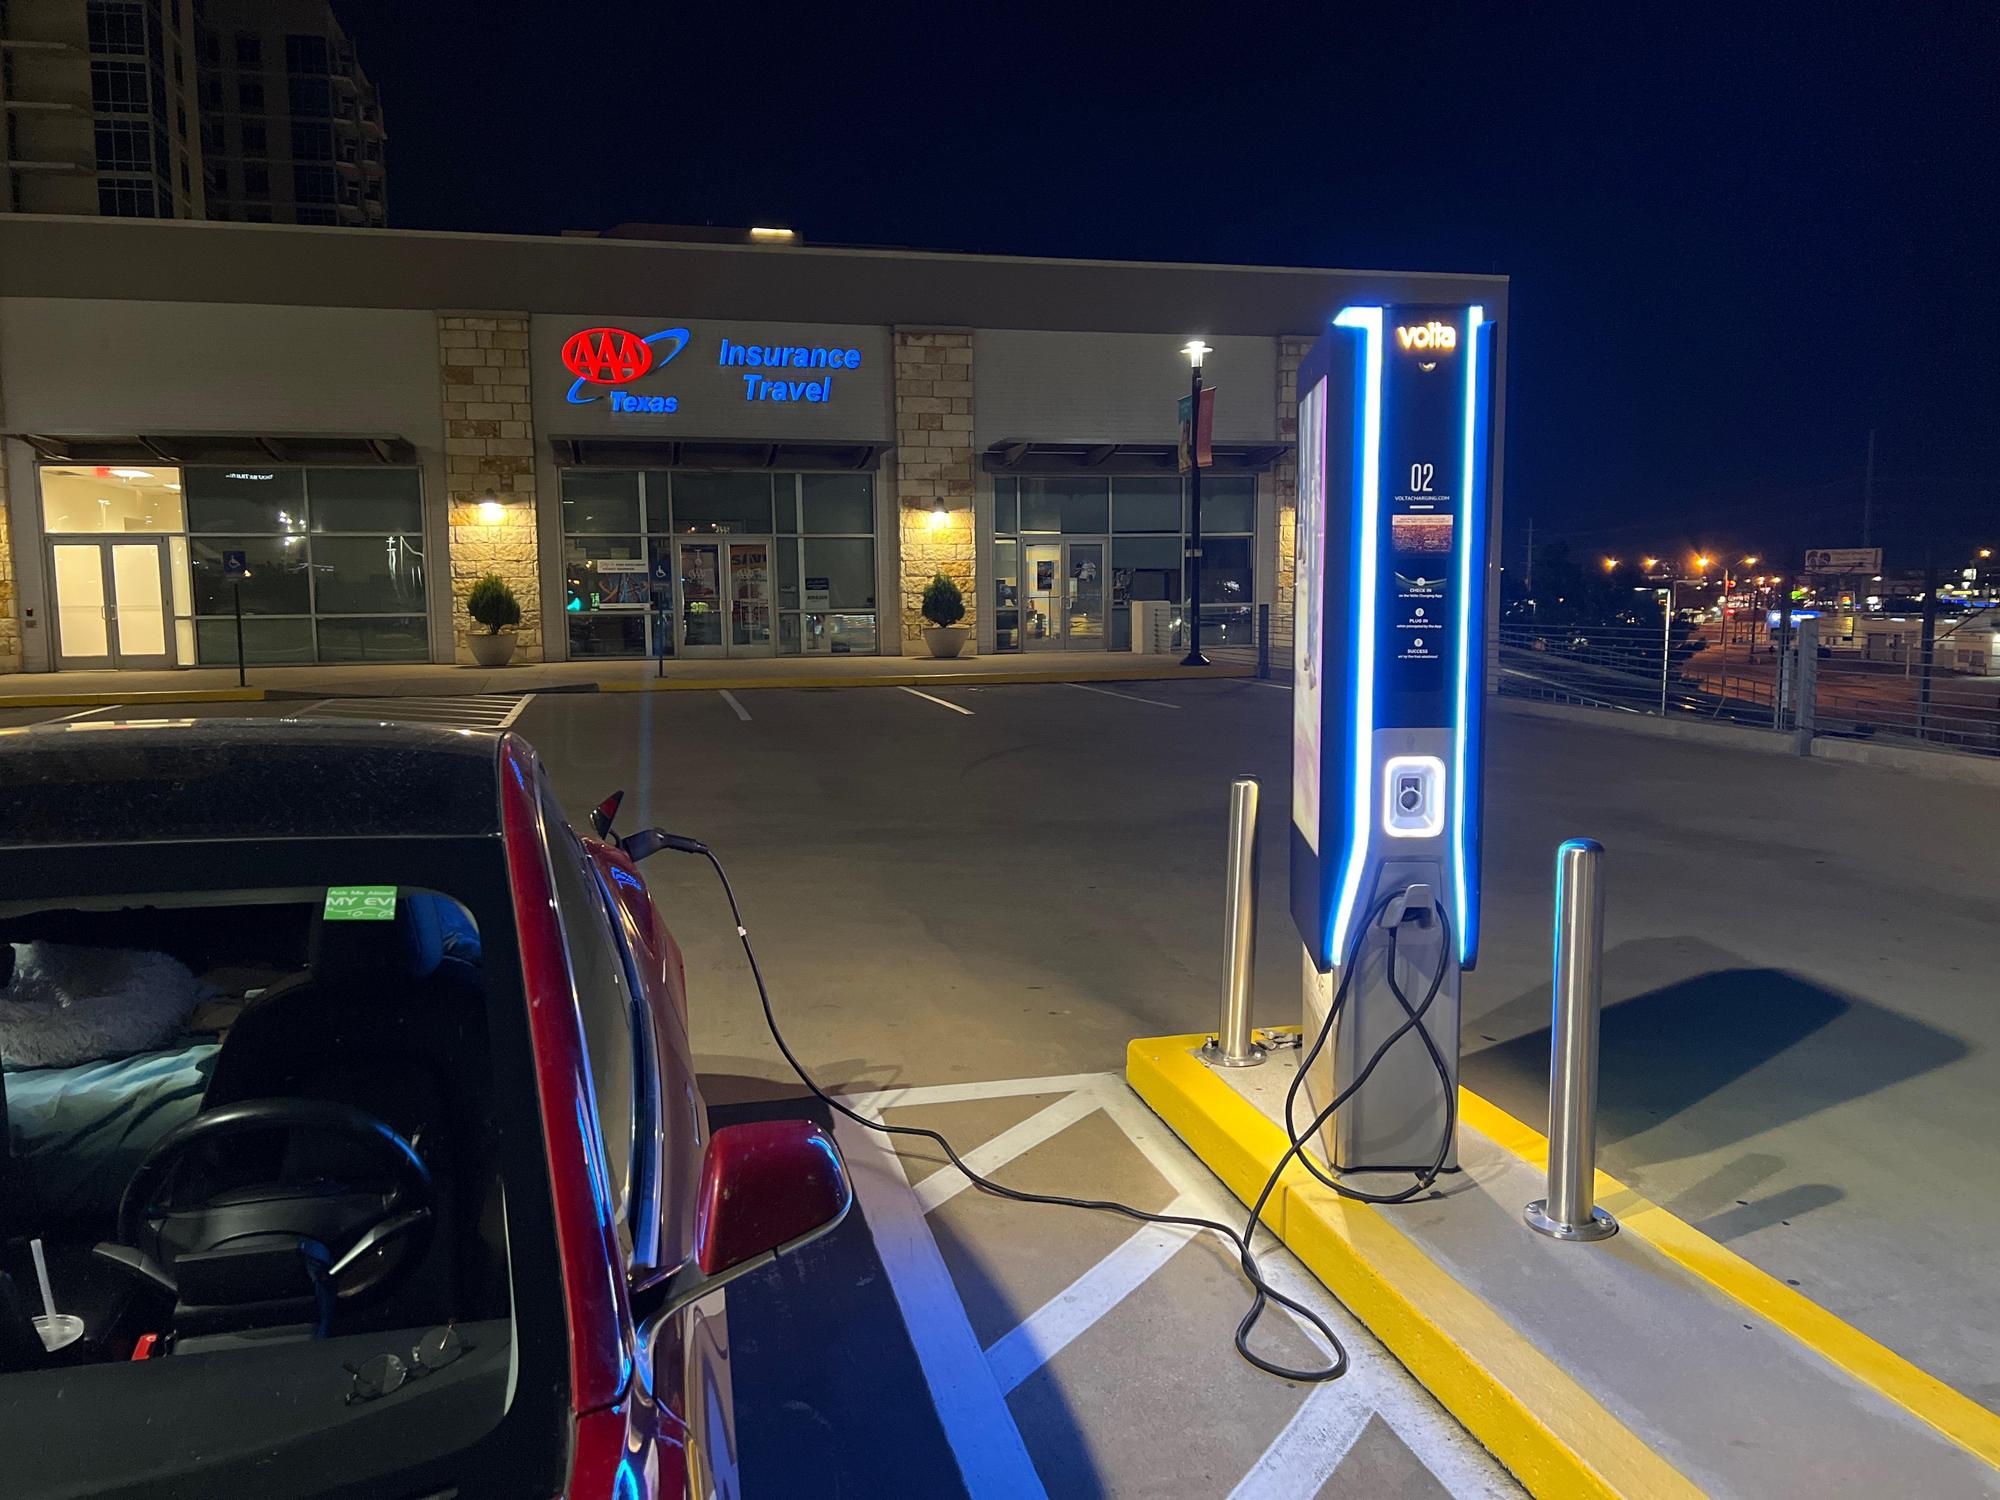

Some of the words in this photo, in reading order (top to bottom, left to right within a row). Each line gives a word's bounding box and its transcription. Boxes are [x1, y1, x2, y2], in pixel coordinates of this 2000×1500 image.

[1397, 322, 1457, 350] volta
[567, 328, 648, 384] AAA
[719, 339, 862, 369] Insurance
[743, 374, 832, 402] Travel
[610, 391, 679, 414] Texas
[1411, 463, 1434, 492] 02
[327, 896, 358, 906] MY
